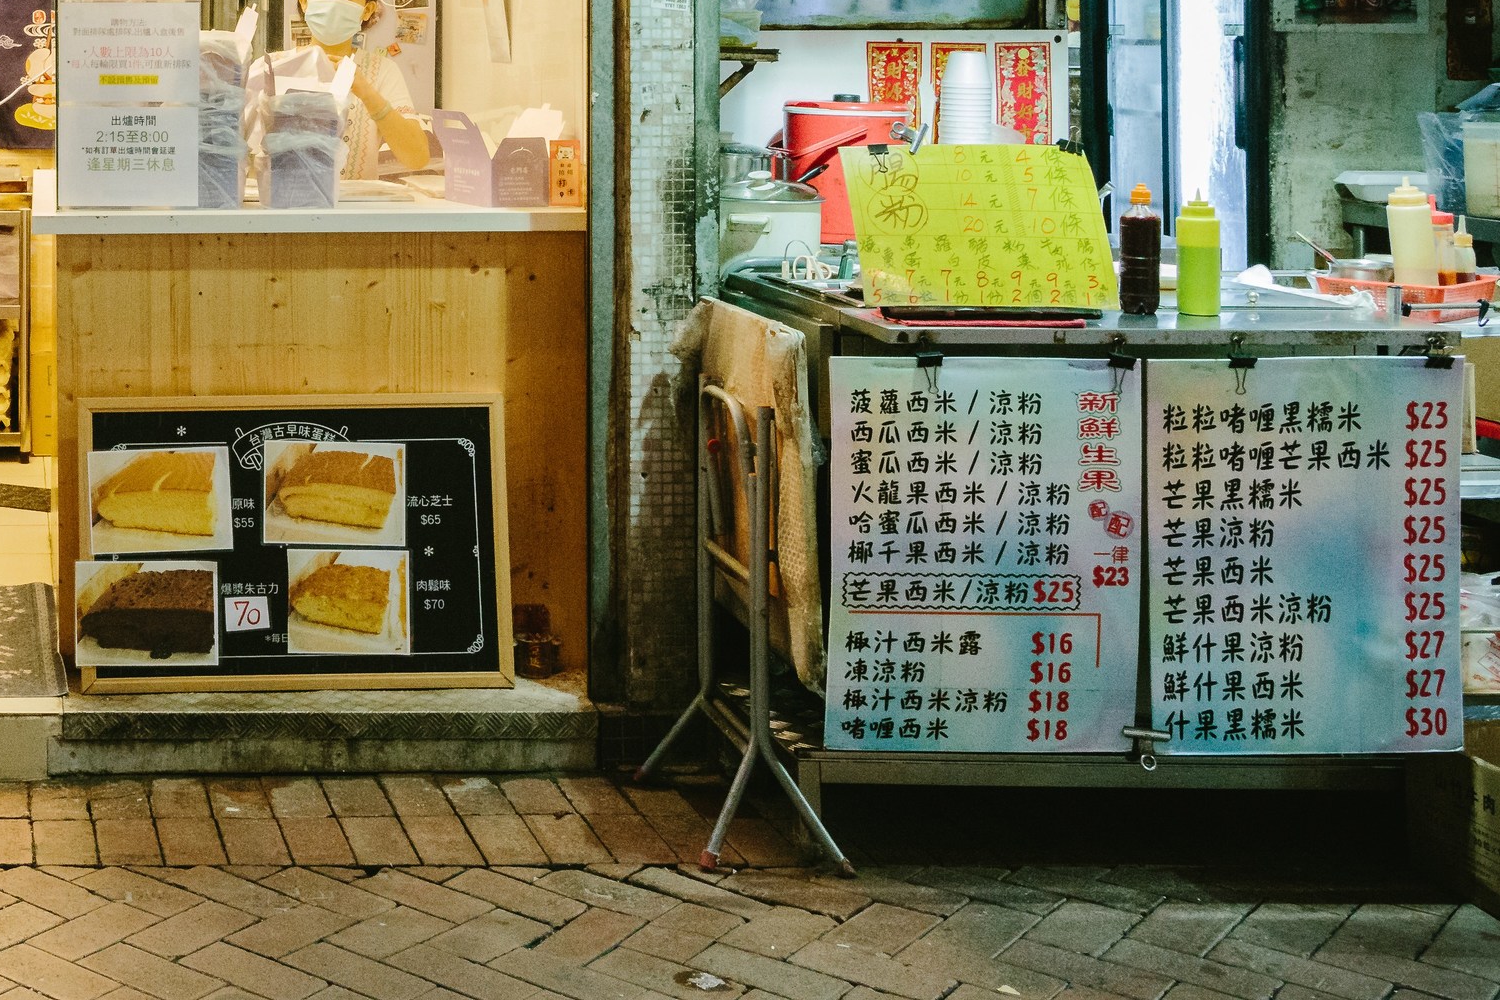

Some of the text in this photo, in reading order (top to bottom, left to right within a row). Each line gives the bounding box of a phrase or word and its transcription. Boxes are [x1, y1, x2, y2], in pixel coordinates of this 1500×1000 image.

[111, 115, 157, 127] 出爐時間
[96, 130, 169, 143] 2:15至8:00
[87, 157, 176, 172] 逢星期三休息
[1162, 401, 1449, 434] 粒粒啫喱黑糯米 $23
[249, 424, 337, 446] 台灣古早味蛋糕
[851, 419, 1043, 446] 西瓜西米/涼粉
[1077, 391, 1122, 493] 新鮮生果
[850, 449, 1043, 476] 蜜瓜西米/涼粉
[1162, 439, 1448, 472] 粒粒啫喱芒果西米 $25
[232, 494, 453, 511] 原味 流心芝士
[1162, 477, 1447, 511] 芒果黑糯米 $25
[233, 514, 441, 529] $55 $65
[1162, 515, 1447, 549] 芒果涼粉 $25
[1093, 545, 1130, 564] 一律
[1093, 566, 1130, 588] $23
[1162, 553, 1446, 587] 芒果西米 $25
[220, 579, 452, 596] 爆漿朱古力 肉鬆味
[1033, 580, 1074, 604] $25
[234, 601, 262, 626] 70
[424, 598, 446, 610] $70
[1163, 592, 1446, 625] 芒果西米涼粉 $25
[1031, 631, 1073, 656] $16
[1162, 630, 1446, 664] 鮮什果涼粉 $27
[844, 658, 1072, 685] 凍涼粉 $16
[1163, 668, 1446, 702] 鮮什果西米 $27
[1028, 689, 1070, 714] $18
[842, 717, 1068, 742] 啫喱西米 $18
[1165, 706, 1448, 741] 什果黑糯米 $30
